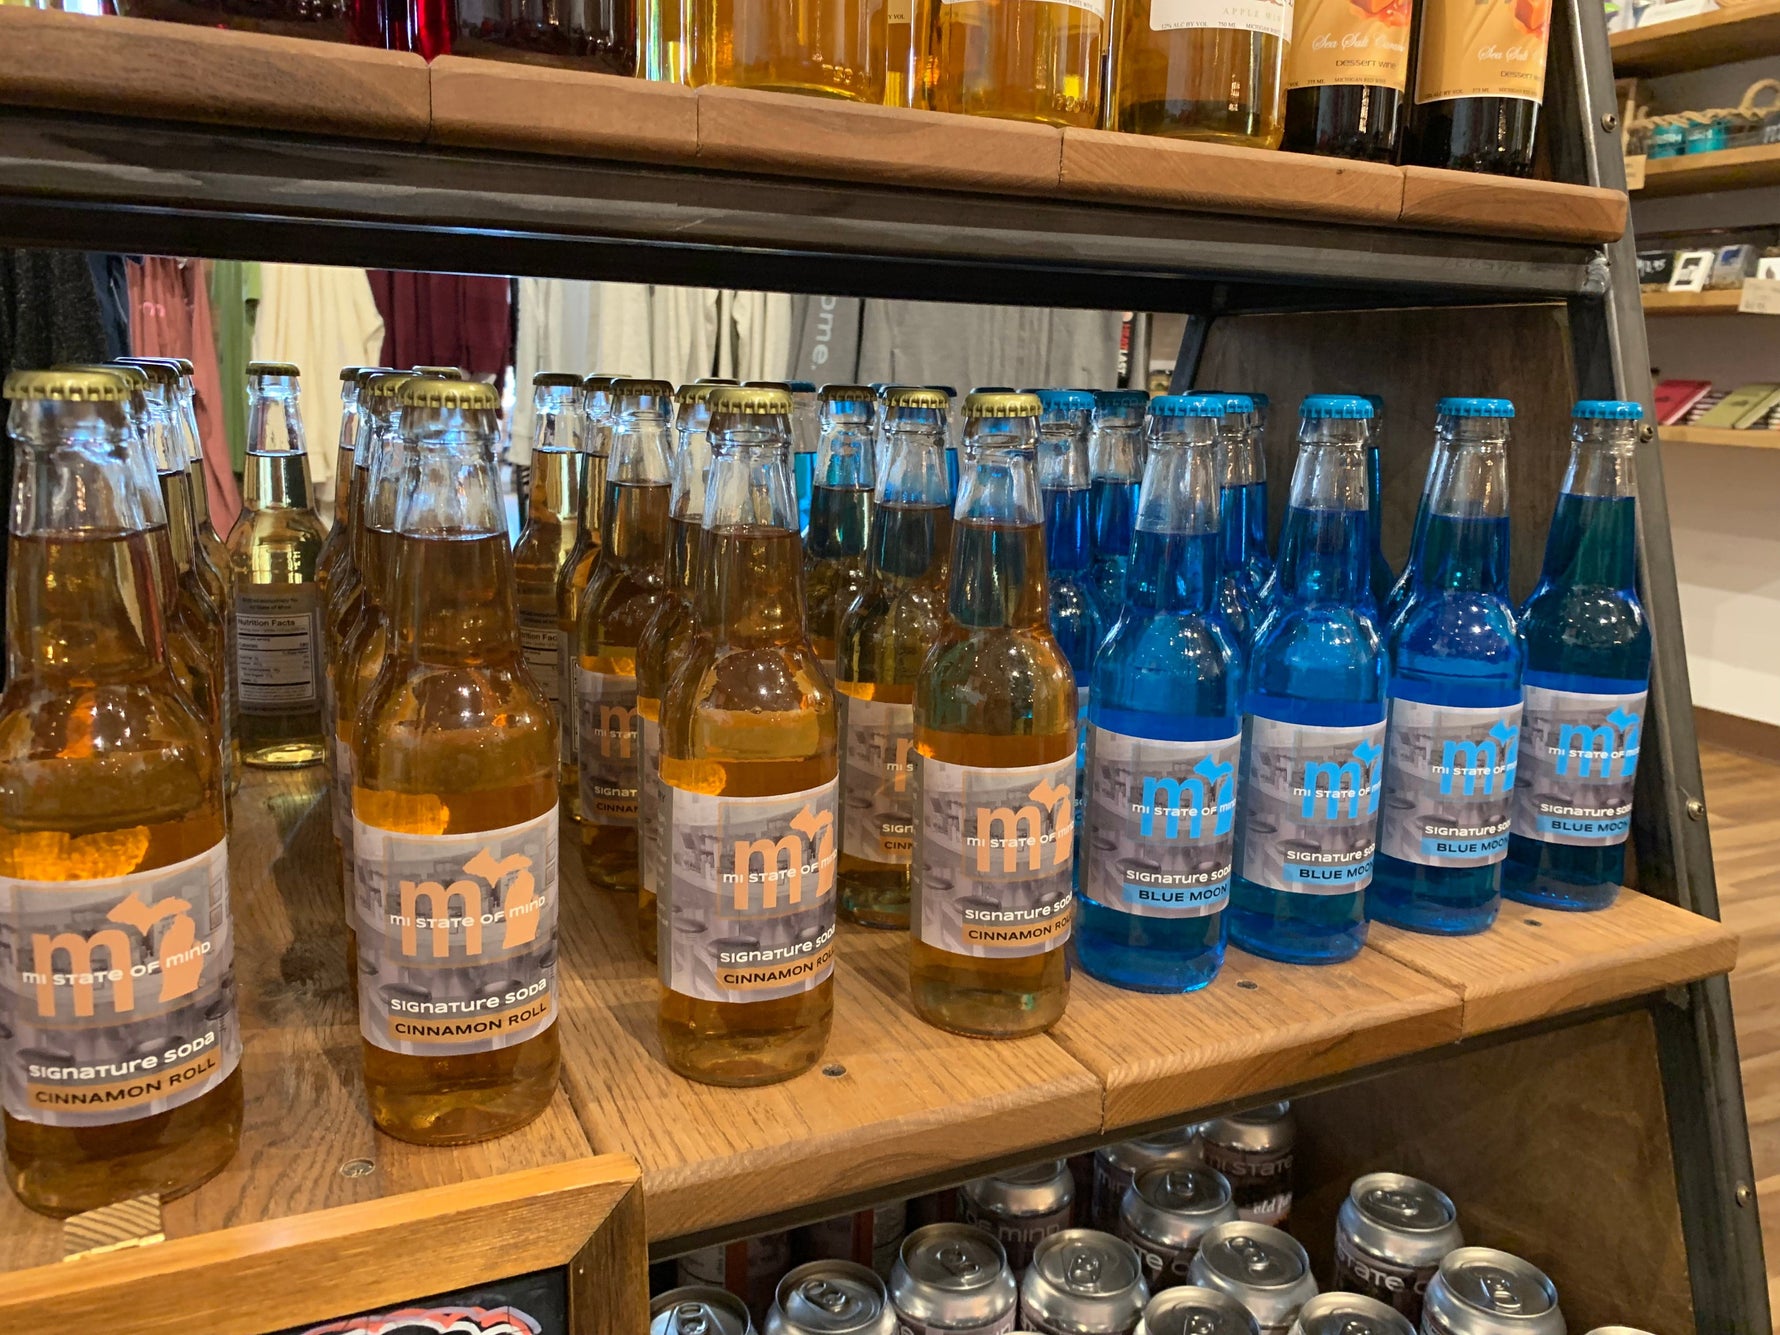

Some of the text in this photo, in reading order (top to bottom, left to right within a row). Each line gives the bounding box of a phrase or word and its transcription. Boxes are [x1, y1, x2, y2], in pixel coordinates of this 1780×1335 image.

[1311, 33, 1339, 52] Sea
[1477, 44, 1504, 62] Sea
[811, 296, 837, 371] ome.
[596, 802, 638, 813] CINNA
[1201, 806, 1217, 816] OF
[1551, 820, 1593, 832] BLUE
[1039, 831, 1056, 845] OF
[1436, 842, 1477, 853] BLUE
[800, 862, 821, 875] OF
[1299, 868, 1343, 880] BLUE
[1139, 885, 1228, 902] BLUE MOON
[480, 910, 505, 925] OF
[968, 925, 1052, 941] CINNAMON
[130, 960, 161, 977] OF
[723, 961, 814, 984] CINNAMON
[395, 1002, 547, 1036] CINNAMON ROLL
[35, 1058, 216, 1105] CINNAMON ROLL
[1253, 1197, 1275, 1214] old
